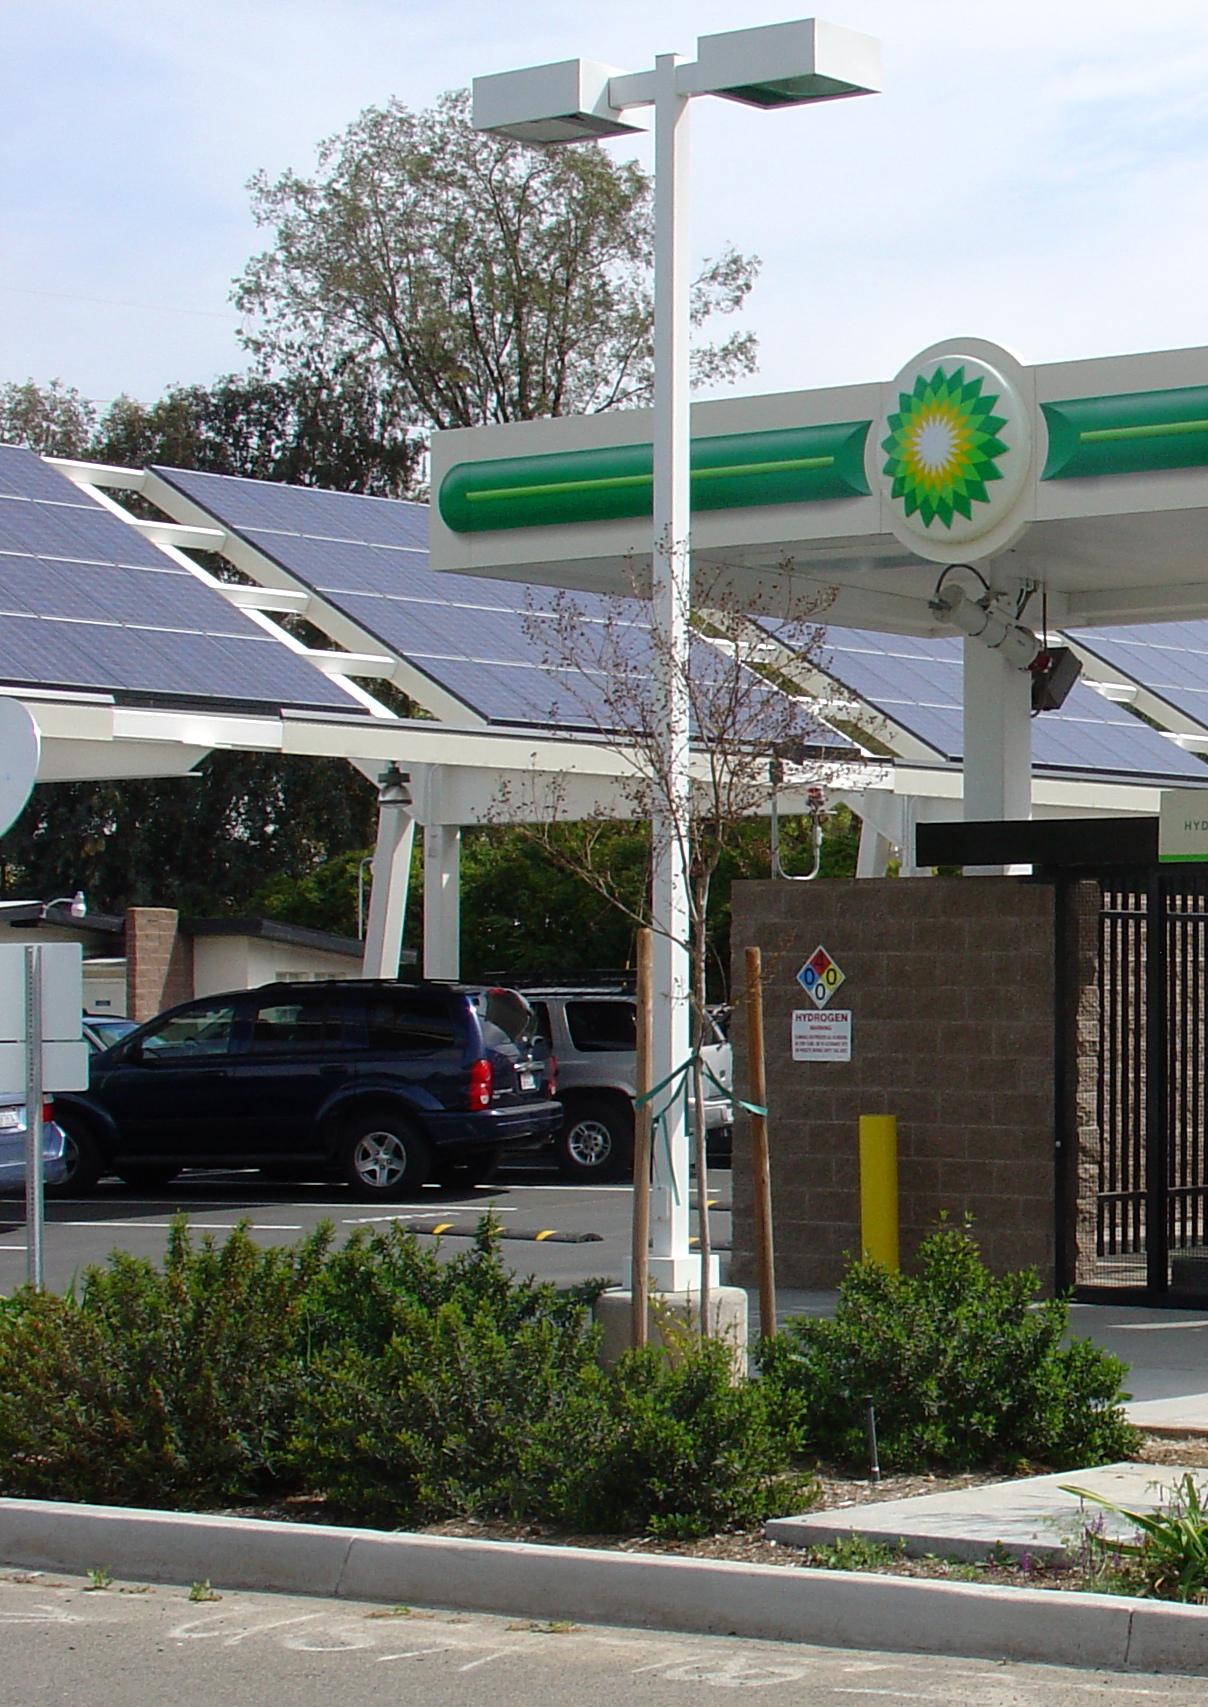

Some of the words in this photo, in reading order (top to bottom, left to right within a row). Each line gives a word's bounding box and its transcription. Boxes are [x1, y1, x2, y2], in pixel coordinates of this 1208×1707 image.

[804, 967, 815, 985] 0
[826, 967, 837, 985] 0
[815, 983, 825, 1000] 0
[795, 1013, 849, 1022] HYDROGEN
